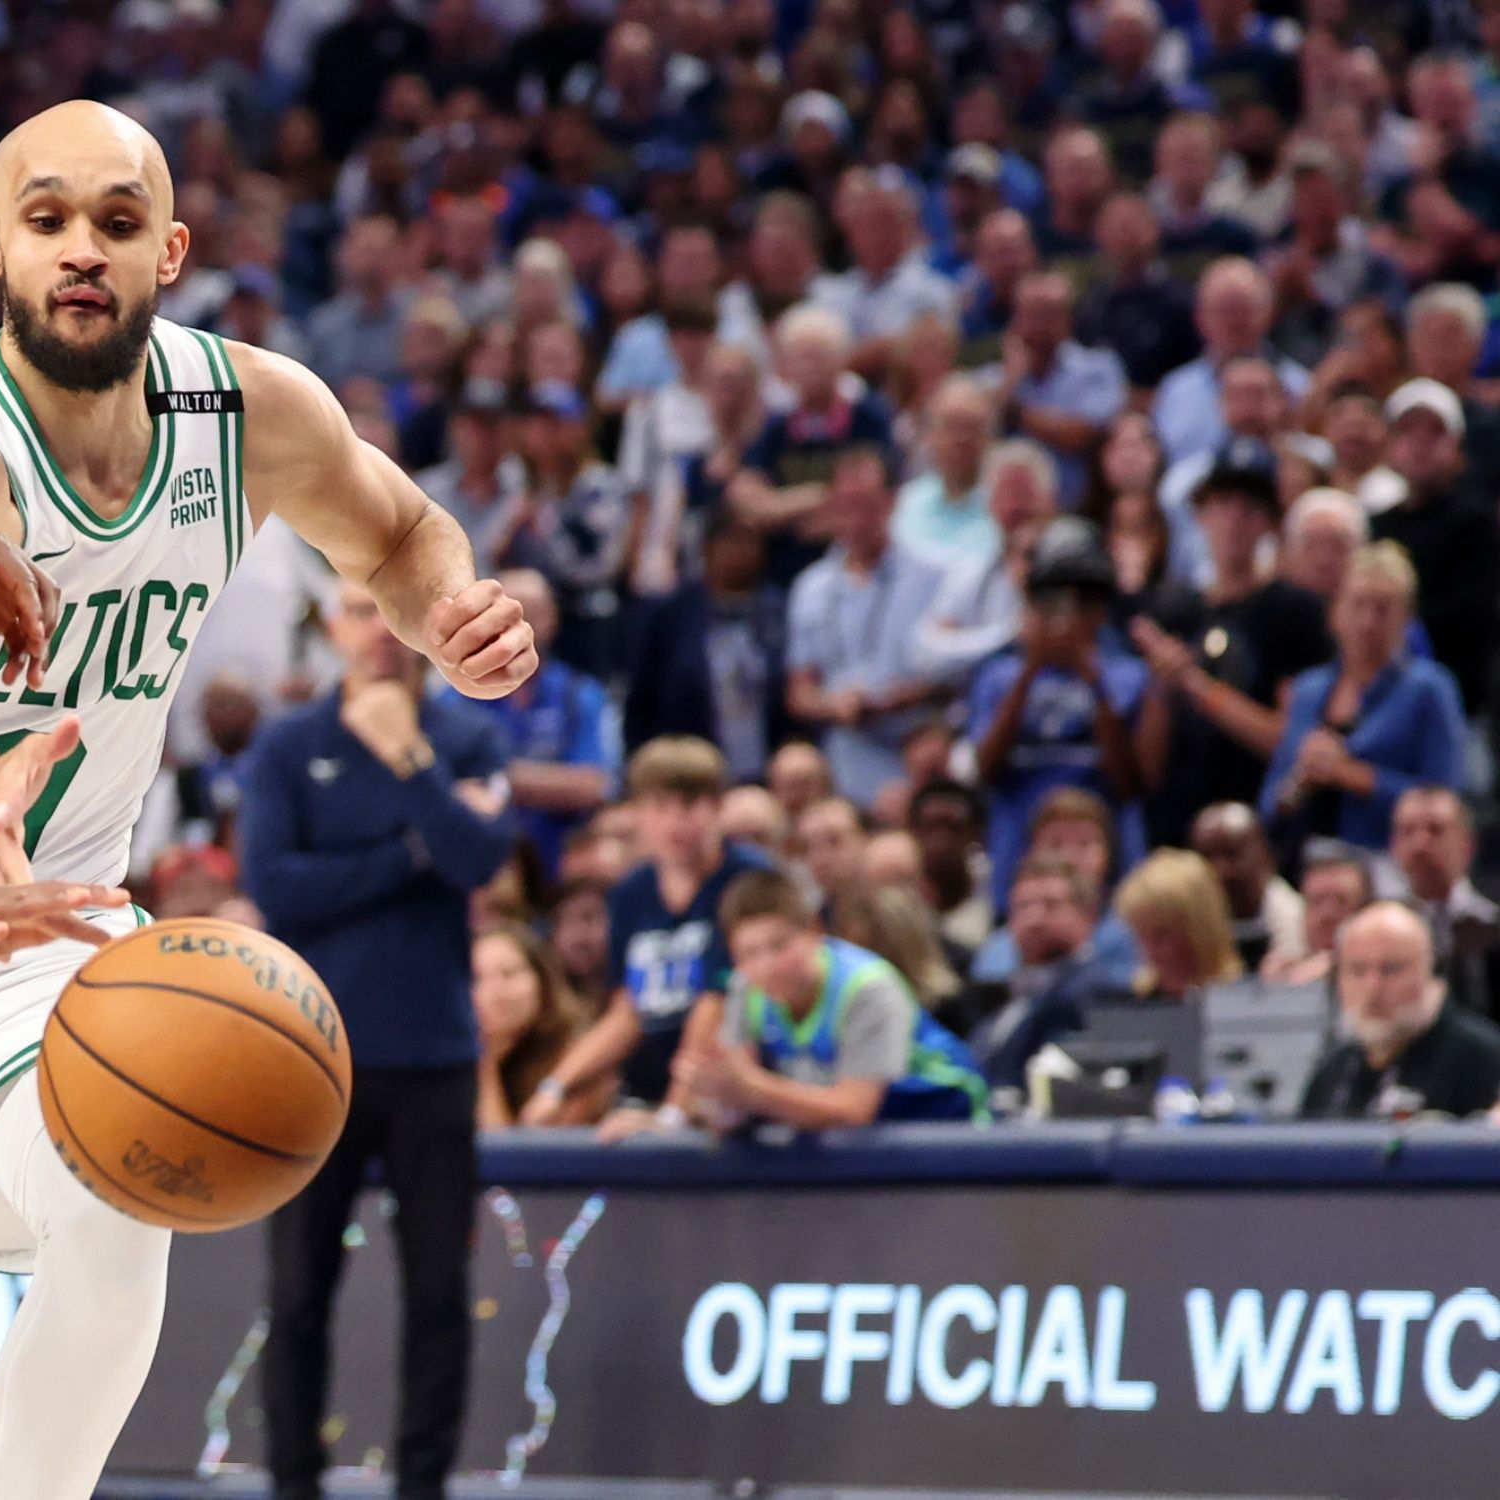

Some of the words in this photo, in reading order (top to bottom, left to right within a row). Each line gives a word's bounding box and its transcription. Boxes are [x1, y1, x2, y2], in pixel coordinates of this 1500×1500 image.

[167, 393, 223, 411] WALTON
[170, 467, 217, 505] VISTA
[170, 496, 217, 529] PRINT
[156, 933, 340, 1054] Wilson
[682, 1280, 1160, 1412] OFFICIAL
[1185, 1287, 1500, 1421] WATC
